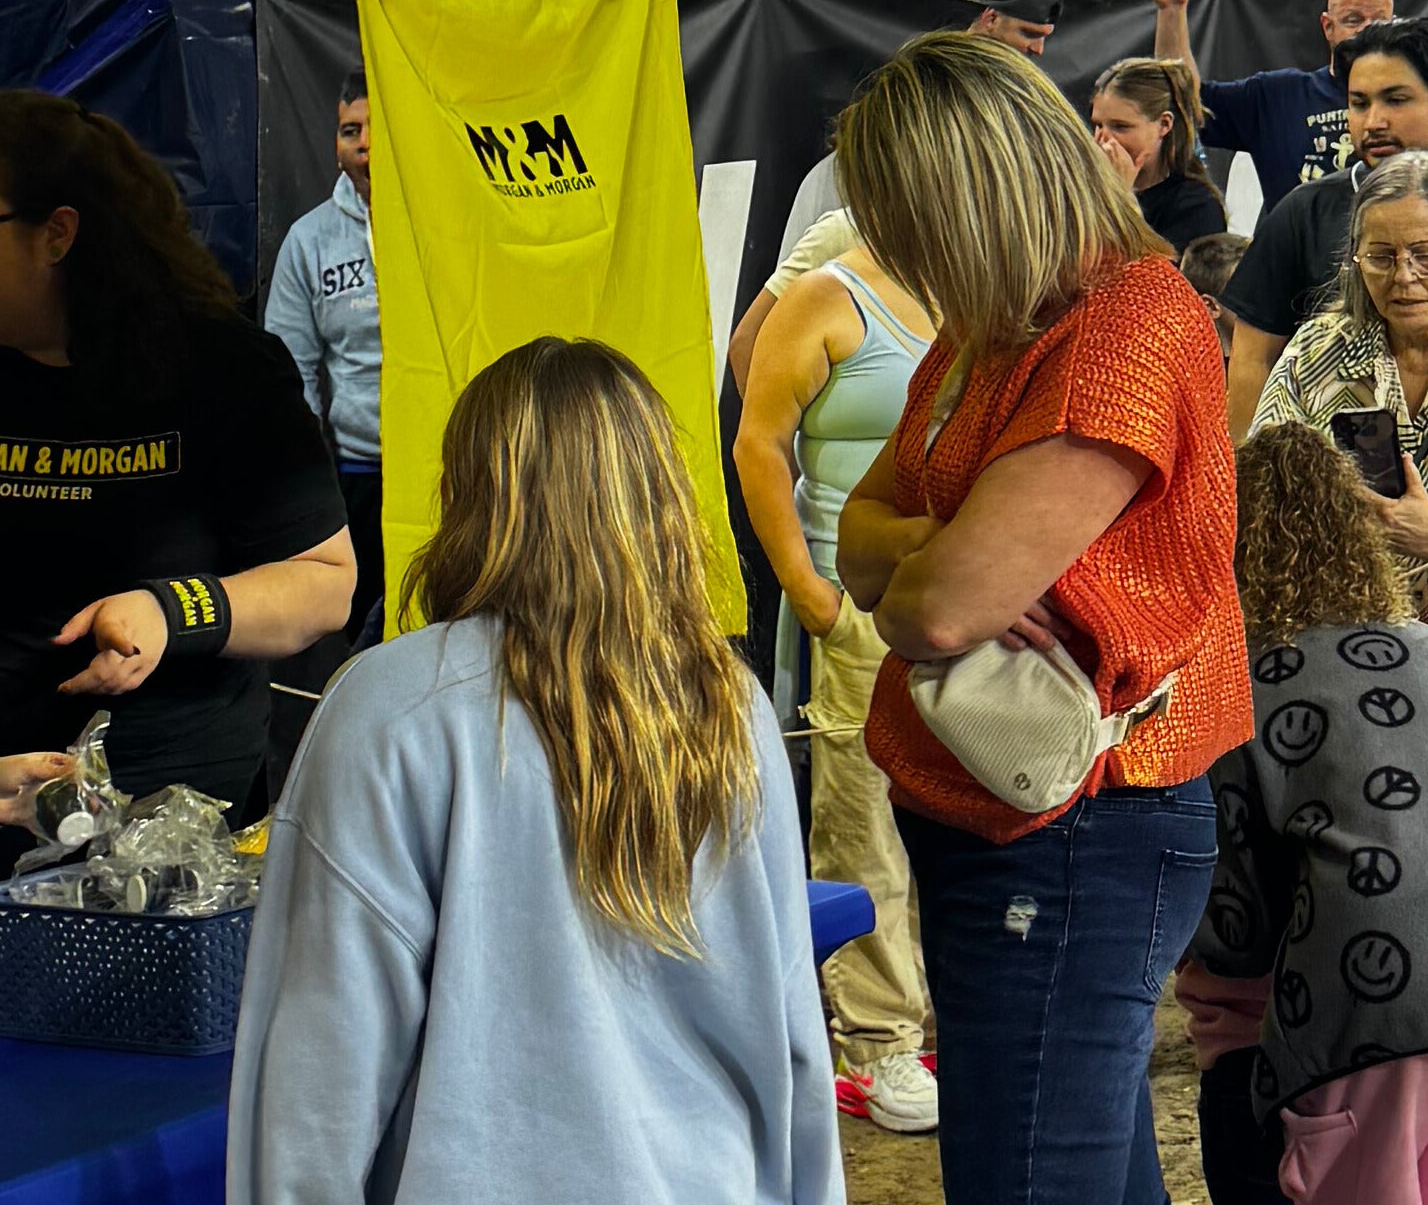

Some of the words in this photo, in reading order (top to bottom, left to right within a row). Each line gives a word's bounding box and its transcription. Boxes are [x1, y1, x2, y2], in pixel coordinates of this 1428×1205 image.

[464, 114, 588, 182] M&M
[544, 175, 596, 196] MORGAN
[323, 258, 366, 296] SIX
[34, 446, 52, 474] &
[60, 440, 166, 475] MORGAN
